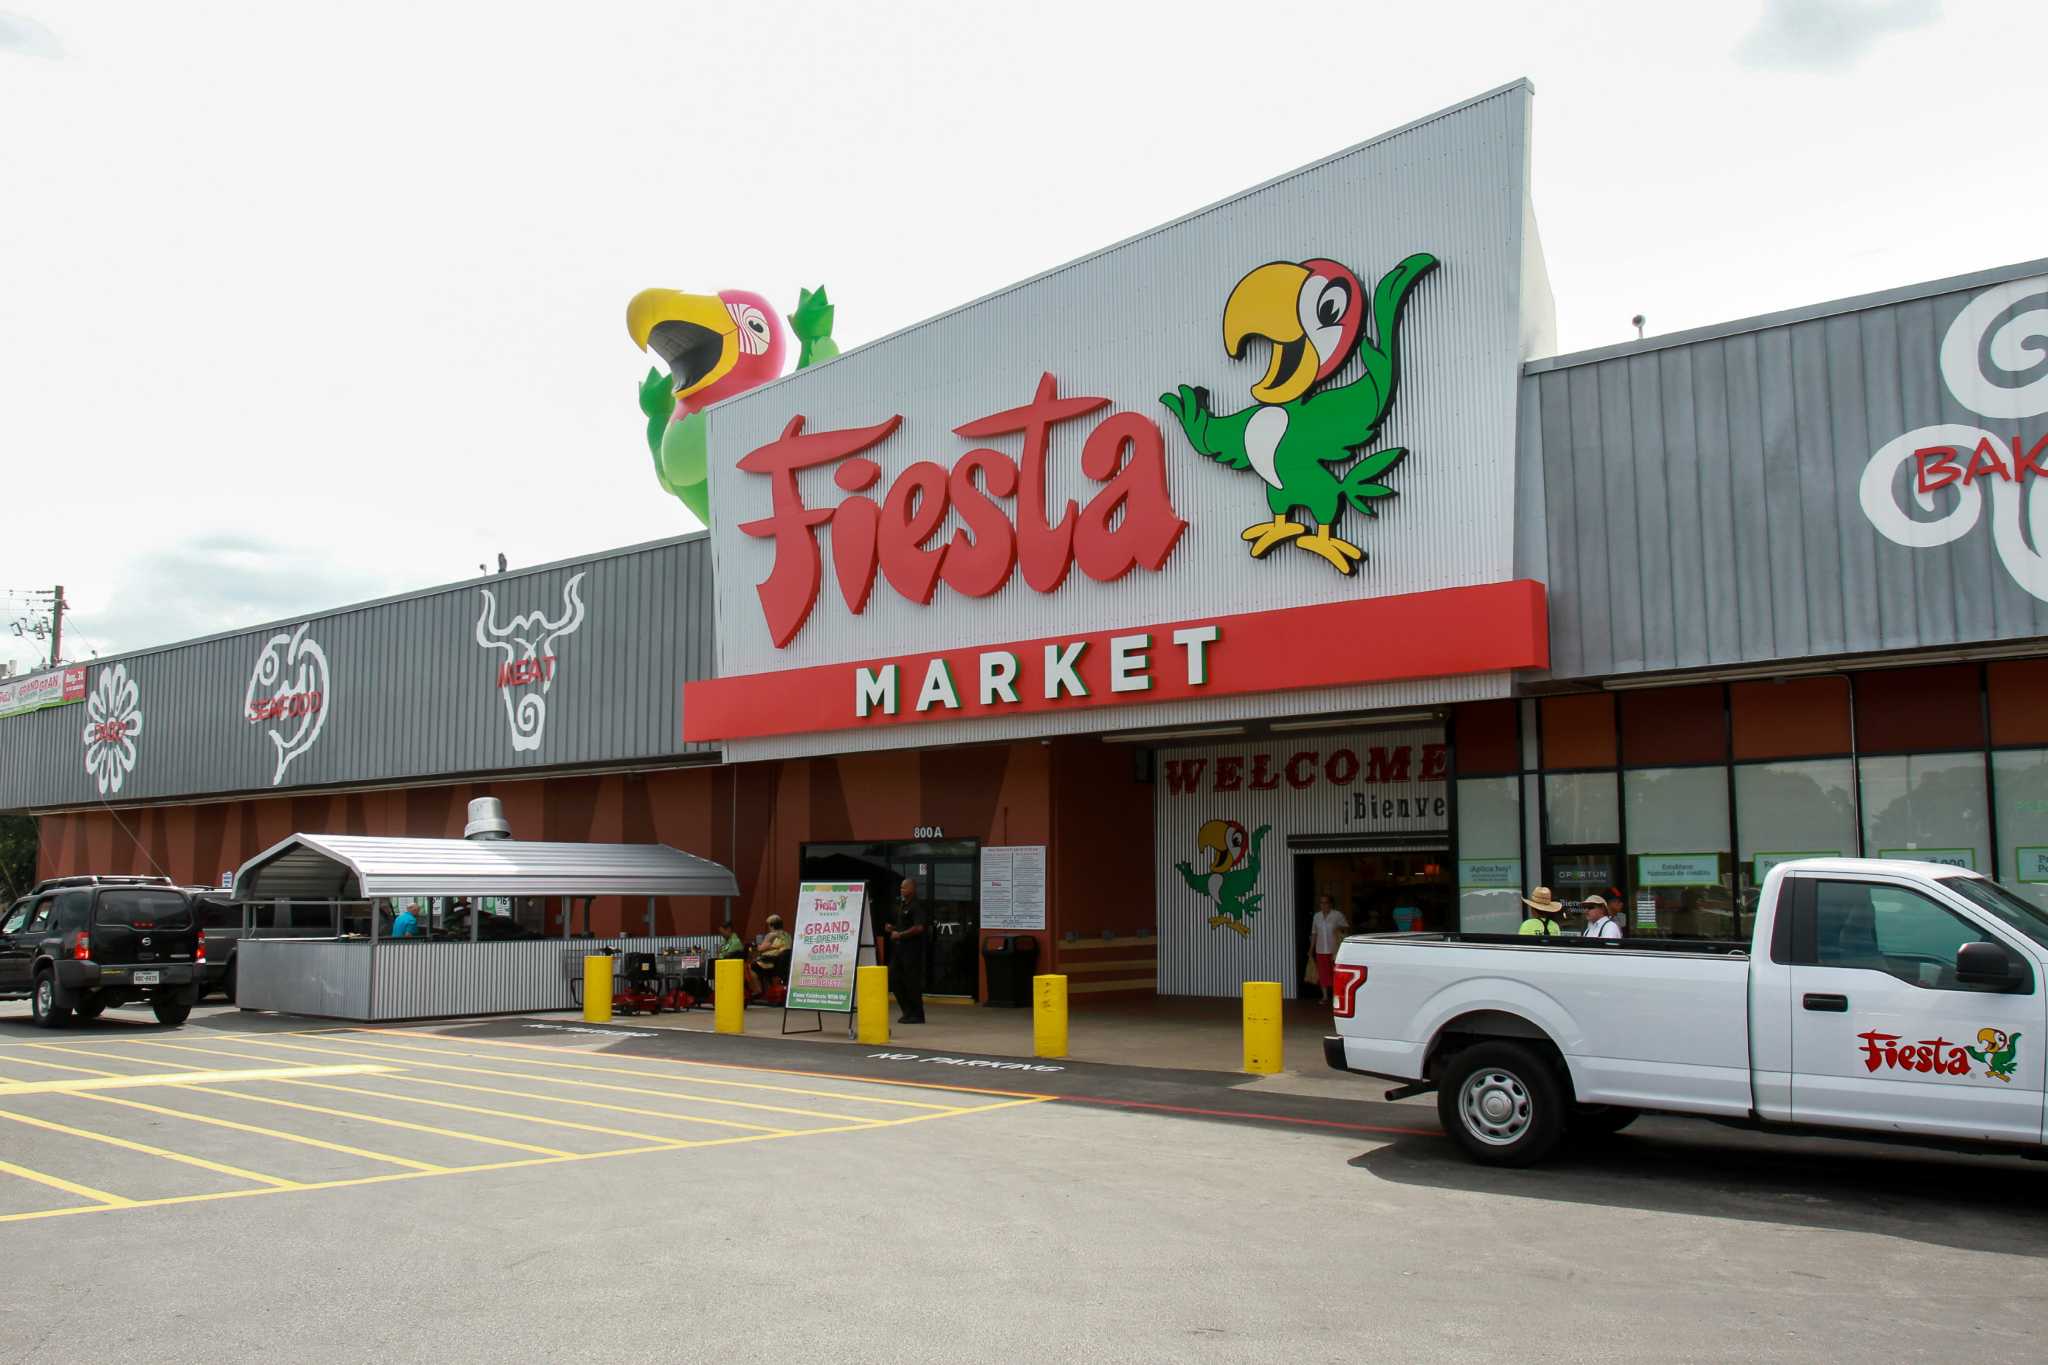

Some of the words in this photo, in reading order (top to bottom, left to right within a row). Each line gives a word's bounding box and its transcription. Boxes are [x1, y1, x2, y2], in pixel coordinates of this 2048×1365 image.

[736, 371, 1189, 649] Fiesta
[496, 655, 557, 688] MEAT
[856, 625, 1219, 717] MARKET
[248, 691, 321, 721] SEAFOOD
[1164, 743, 1448, 797] WELCOME
[804, 920, 850, 936] GRAND
[810, 943, 840, 954] GRAN
[802, 962, 828, 977] Aug.
[918, 1056, 1065, 1072] PARKING
[1856, 1029, 1972, 1076] Fiesta
